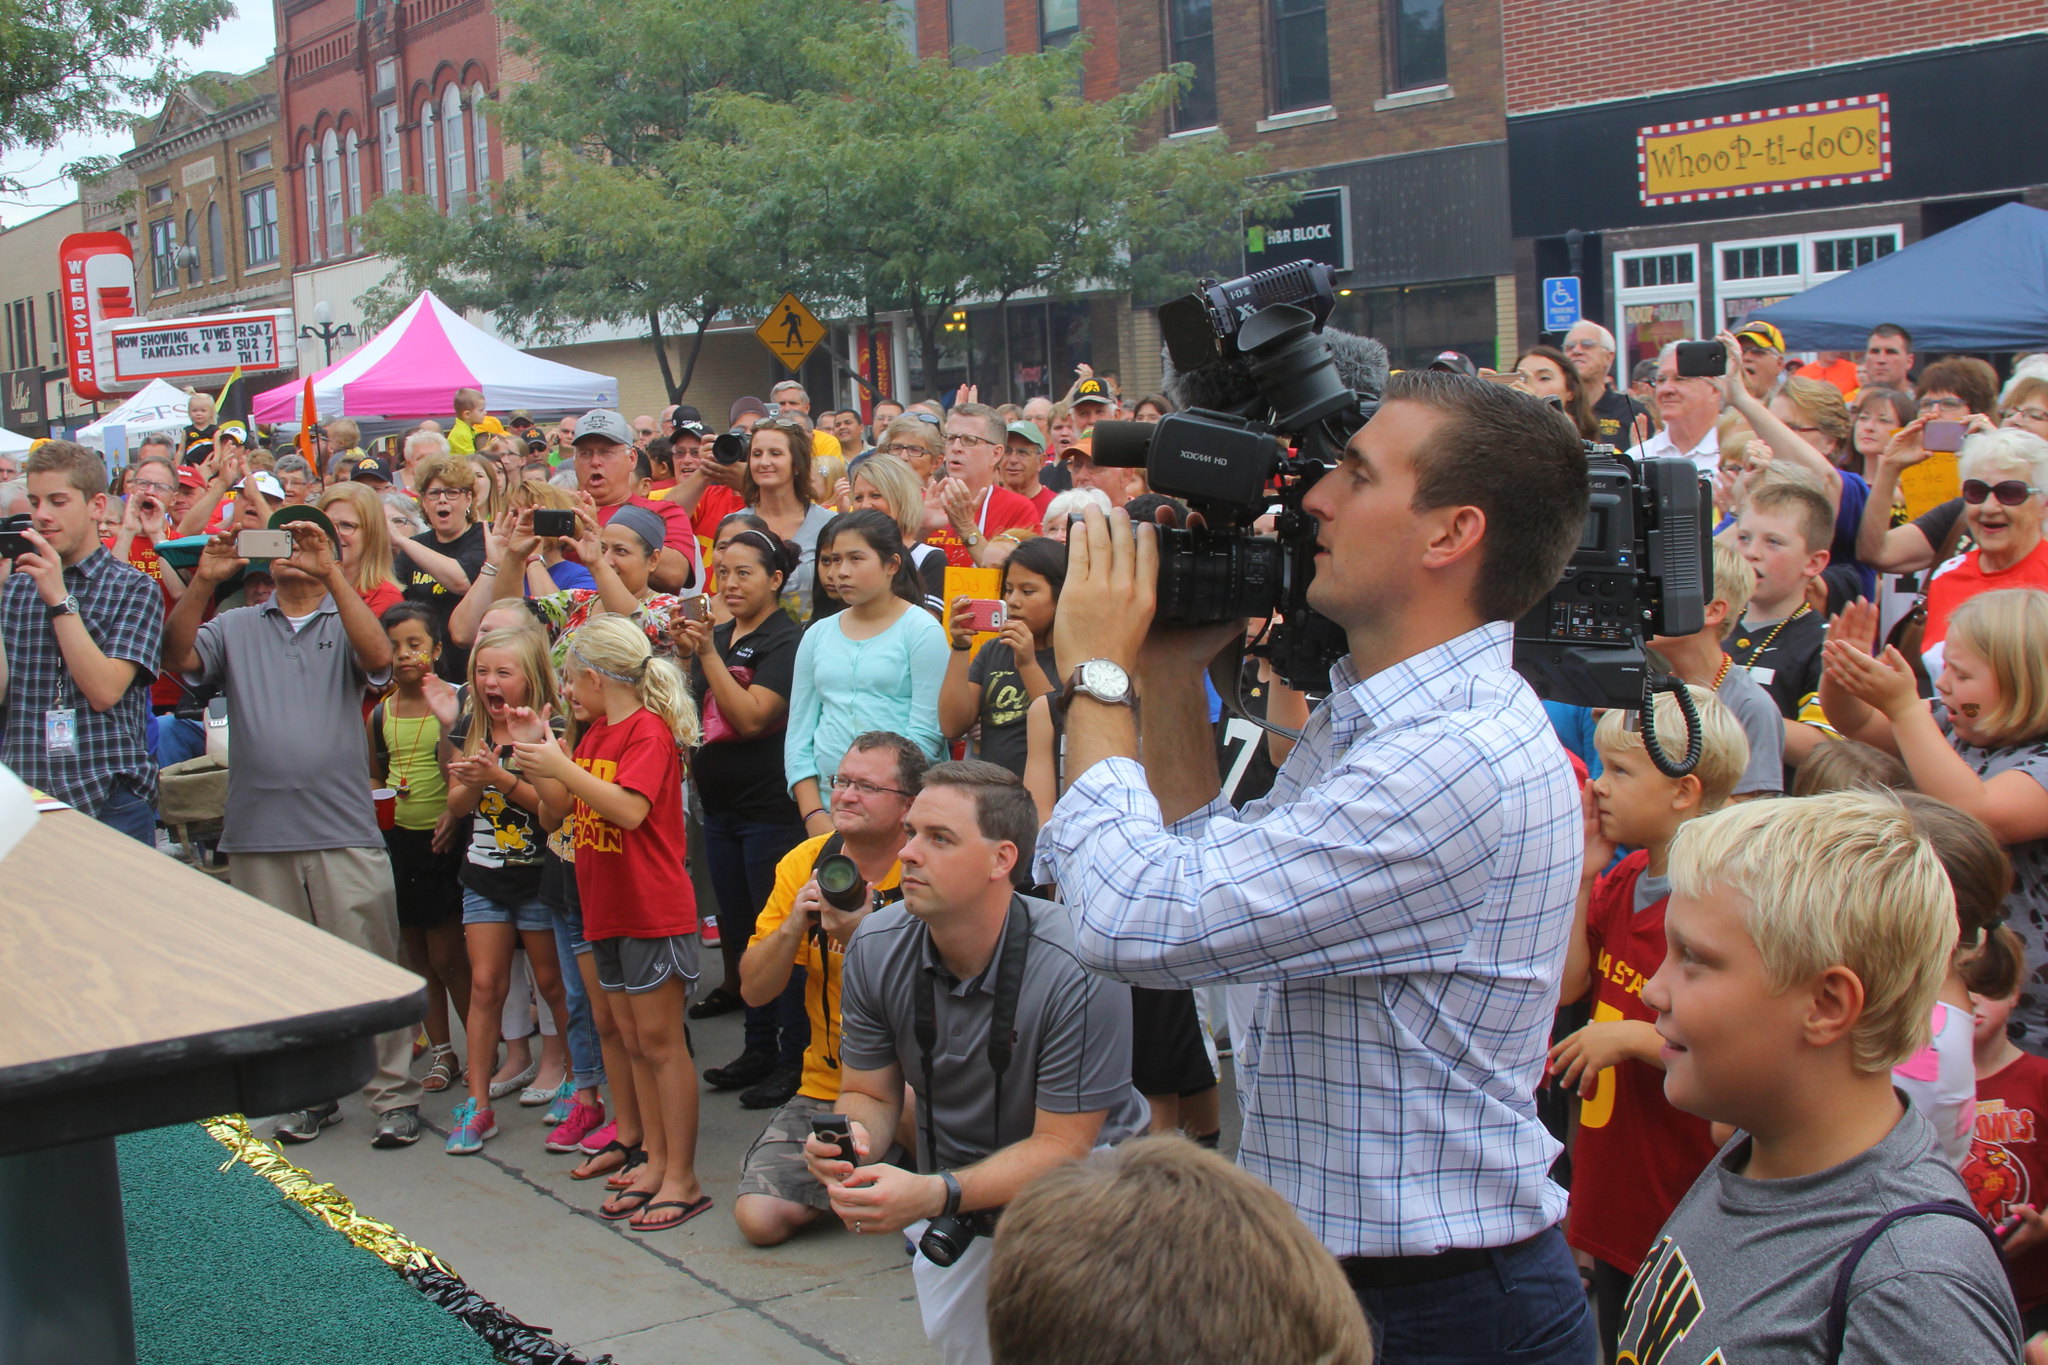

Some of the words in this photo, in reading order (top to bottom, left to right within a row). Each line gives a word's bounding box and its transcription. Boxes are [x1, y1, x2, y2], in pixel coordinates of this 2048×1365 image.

[1293, 224, 1331, 241] BLOCK
[68, 260, 93, 382] WEBSTER
[116, 335, 138, 348] NOW
[140, 331, 188, 346] SHOWING
[264, 323, 271, 335] 7
[141, 343, 200, 359] FANTASTIC
[203, 342, 210, 353] 4
[217, 340, 232, 352] 2D
[266, 336, 272, 348] 7
[238, 351, 252, 363] TH
[265, 349, 272, 361] 7
[1180, 450, 1212, 463] XDCAM
[1214, 457, 1228, 466] HD
[1223, 717, 1264, 801] 7
[574, 820, 623, 853] GAIN
[1975, 1108, 2035, 1143] ONES
